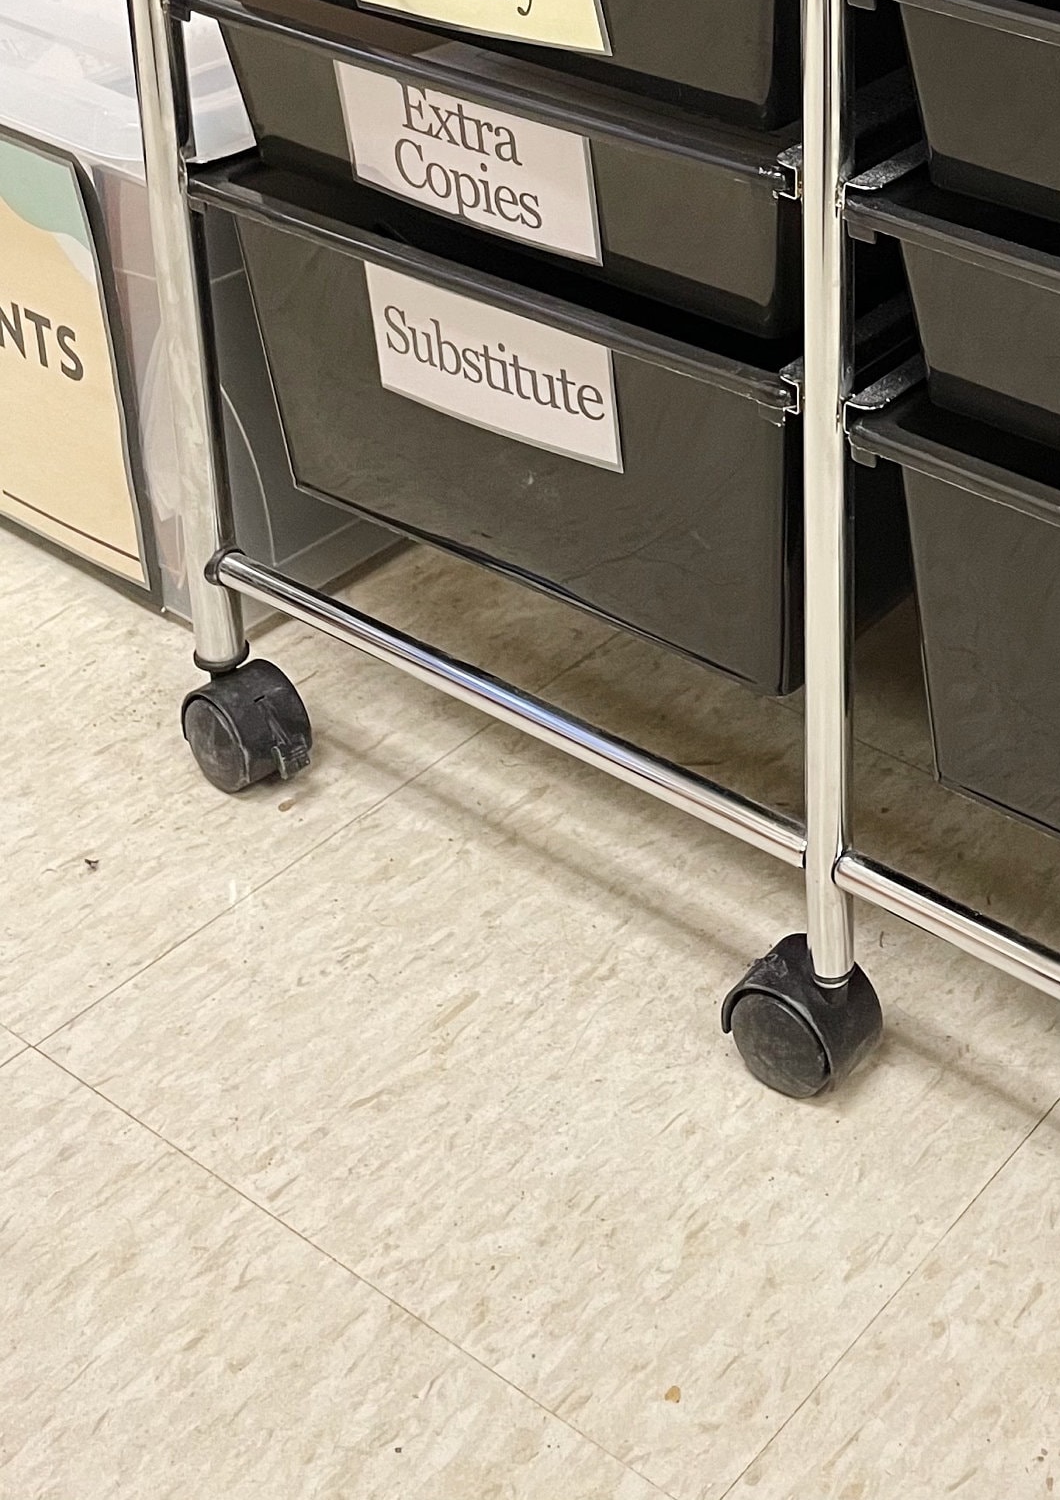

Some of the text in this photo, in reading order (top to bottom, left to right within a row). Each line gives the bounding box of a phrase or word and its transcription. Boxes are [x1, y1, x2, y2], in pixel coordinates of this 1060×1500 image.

[401, 84, 523, 166] Extra
[394, 138, 542, 229] Copies
[384, 305, 605, 421] Substitute
